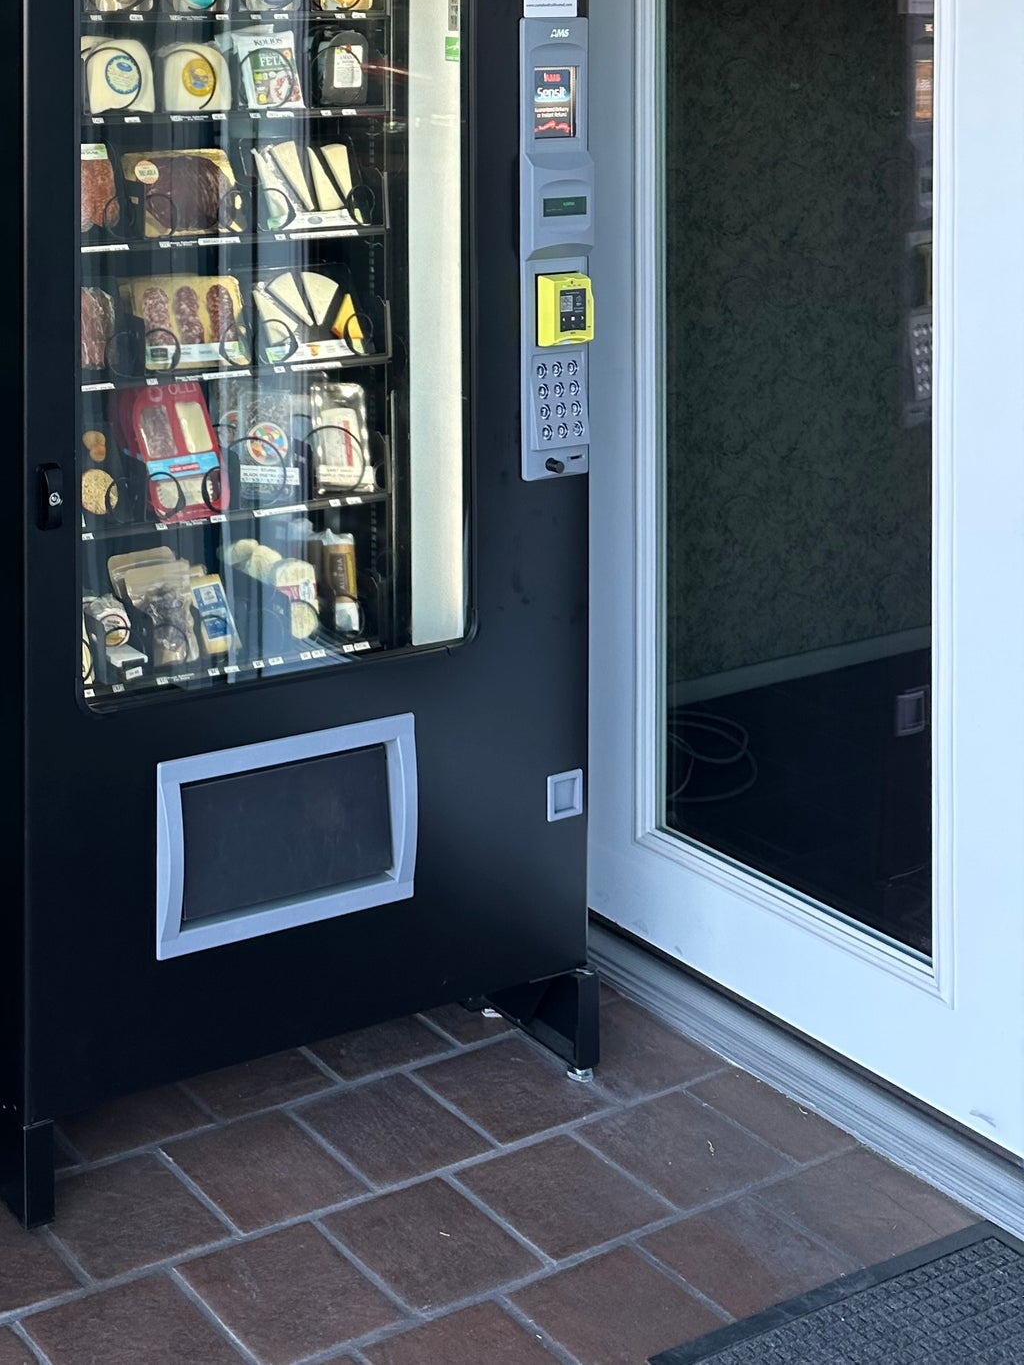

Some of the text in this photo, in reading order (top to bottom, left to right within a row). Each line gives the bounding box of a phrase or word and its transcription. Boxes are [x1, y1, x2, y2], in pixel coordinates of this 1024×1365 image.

[550, 28, 570, 38] AMS
[260, 54, 284, 67] FETA
[537, 86, 567, 99] Sensit
